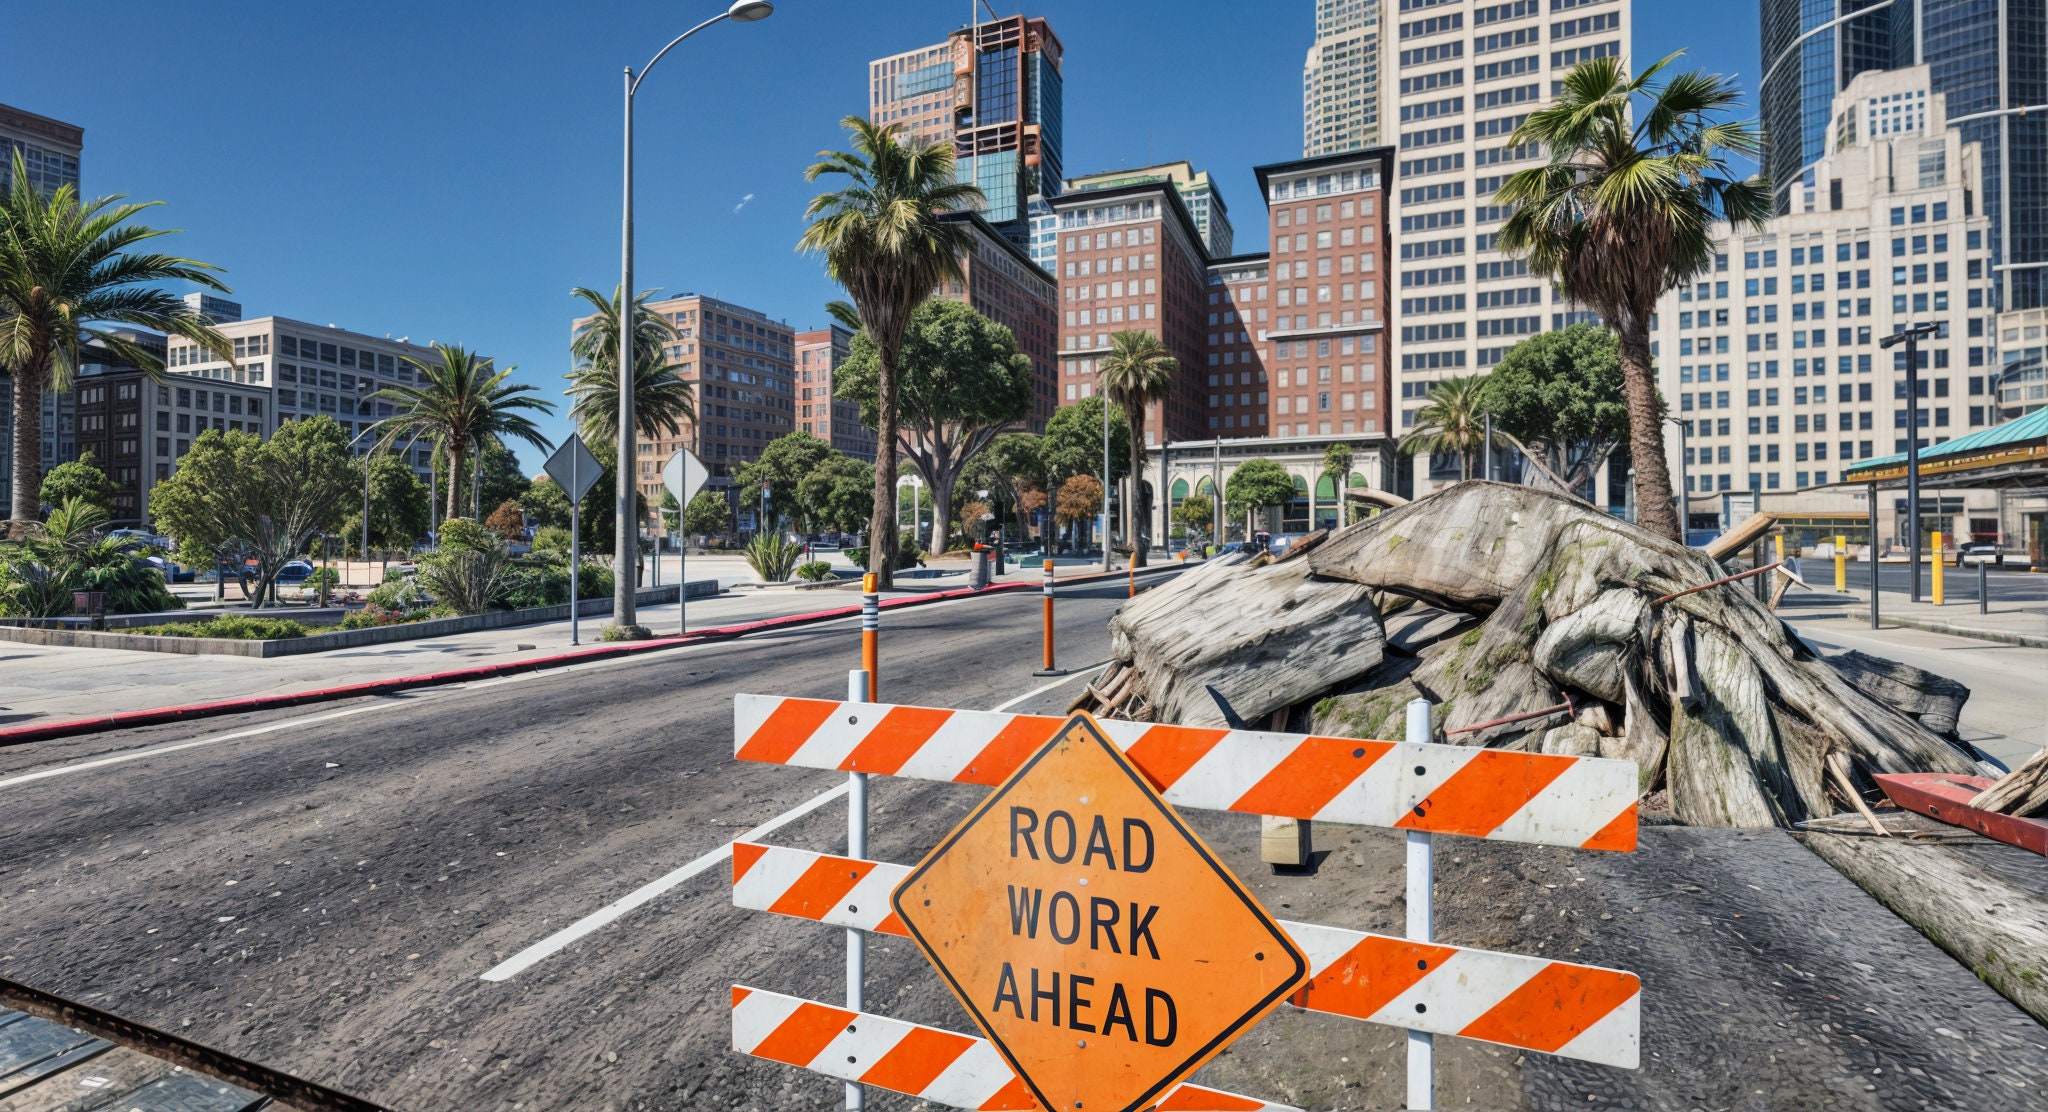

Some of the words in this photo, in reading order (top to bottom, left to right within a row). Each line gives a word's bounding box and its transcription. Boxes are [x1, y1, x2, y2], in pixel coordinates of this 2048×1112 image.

[1010, 806, 1155, 874] ROAD
[1007, 884, 1161, 961] WORK
[992, 962, 1178, 1048] AHEAD
